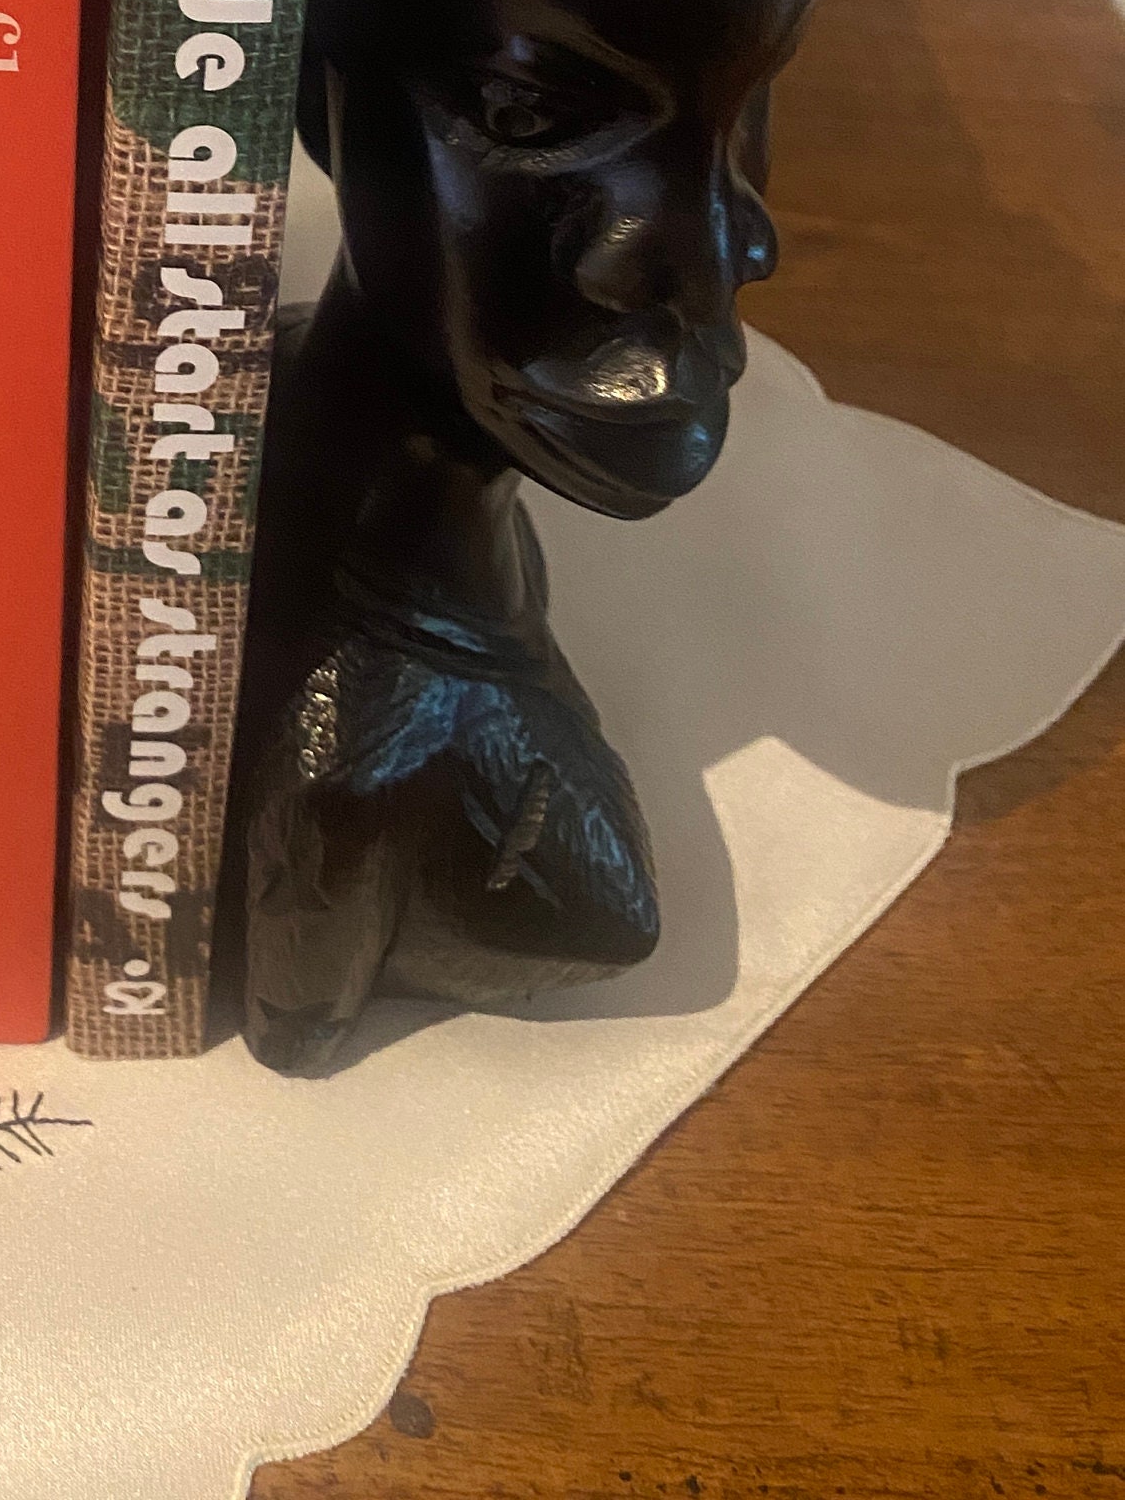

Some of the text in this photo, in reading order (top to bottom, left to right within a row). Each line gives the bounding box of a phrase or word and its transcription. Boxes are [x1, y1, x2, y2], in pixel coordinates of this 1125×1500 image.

[164, 125, 257, 246] all
[149, 267, 245, 460] start
[142, 489, 209, 576] as
[101, 598, 217, 918] strangers
